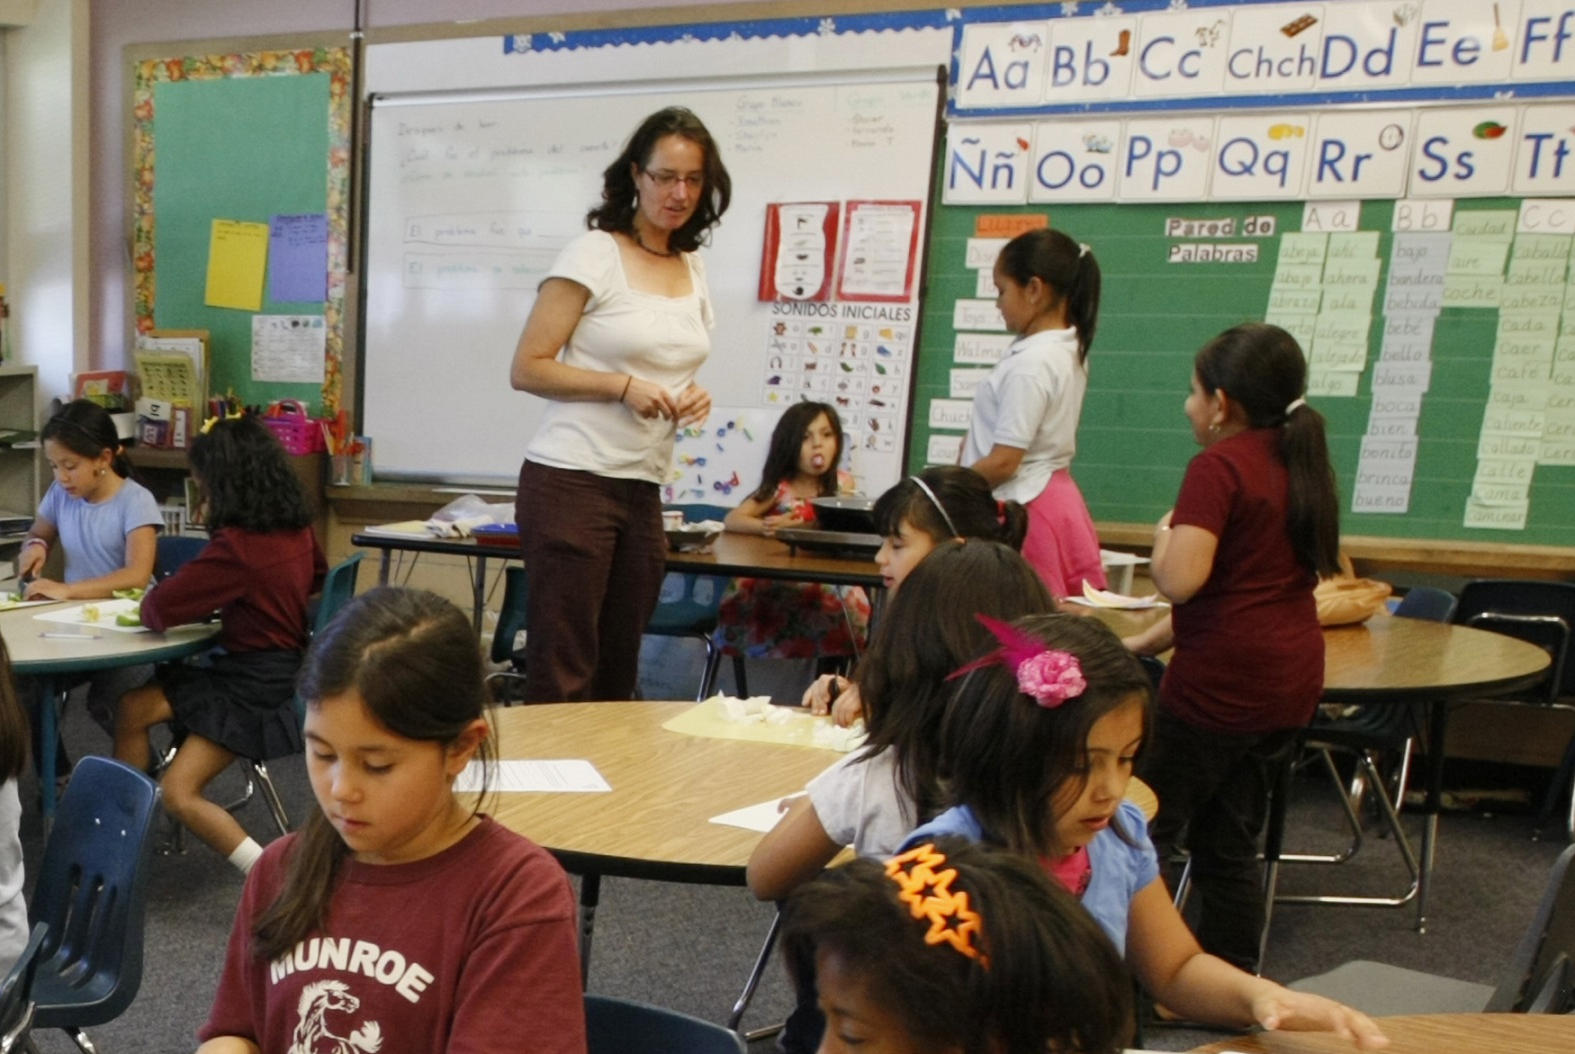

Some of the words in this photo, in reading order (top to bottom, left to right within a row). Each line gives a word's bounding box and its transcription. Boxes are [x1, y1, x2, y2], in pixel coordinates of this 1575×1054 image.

[966, 45, 1030, 90] Aa
[1051, 40, 1111, 87] Bb
[1139, 36, 1202, 81] Cc
[1320, 27, 1397, 79] Dd
[1417, 21, 1481, 67] Ee
[1520, 11, 1575, 64] Ff
[949, 137, 1015, 190] Ññ
[1037, 150, 1105, 190] Oo
[1126, 135, 1183, 191] Pp
[1219, 137, 1290, 188] Qq
[1316, 139, 1373, 182] Rr
[1418, 136, 1475, 182] Ss
[1524, 133, 1573, 180] Tt
[1169, 244, 1256, 261] Palabras
[772, 302, 838, 317] SONIDOS
[842, 305, 912, 321] INICIALES
[270, 937, 435, 1004] MUNROE
